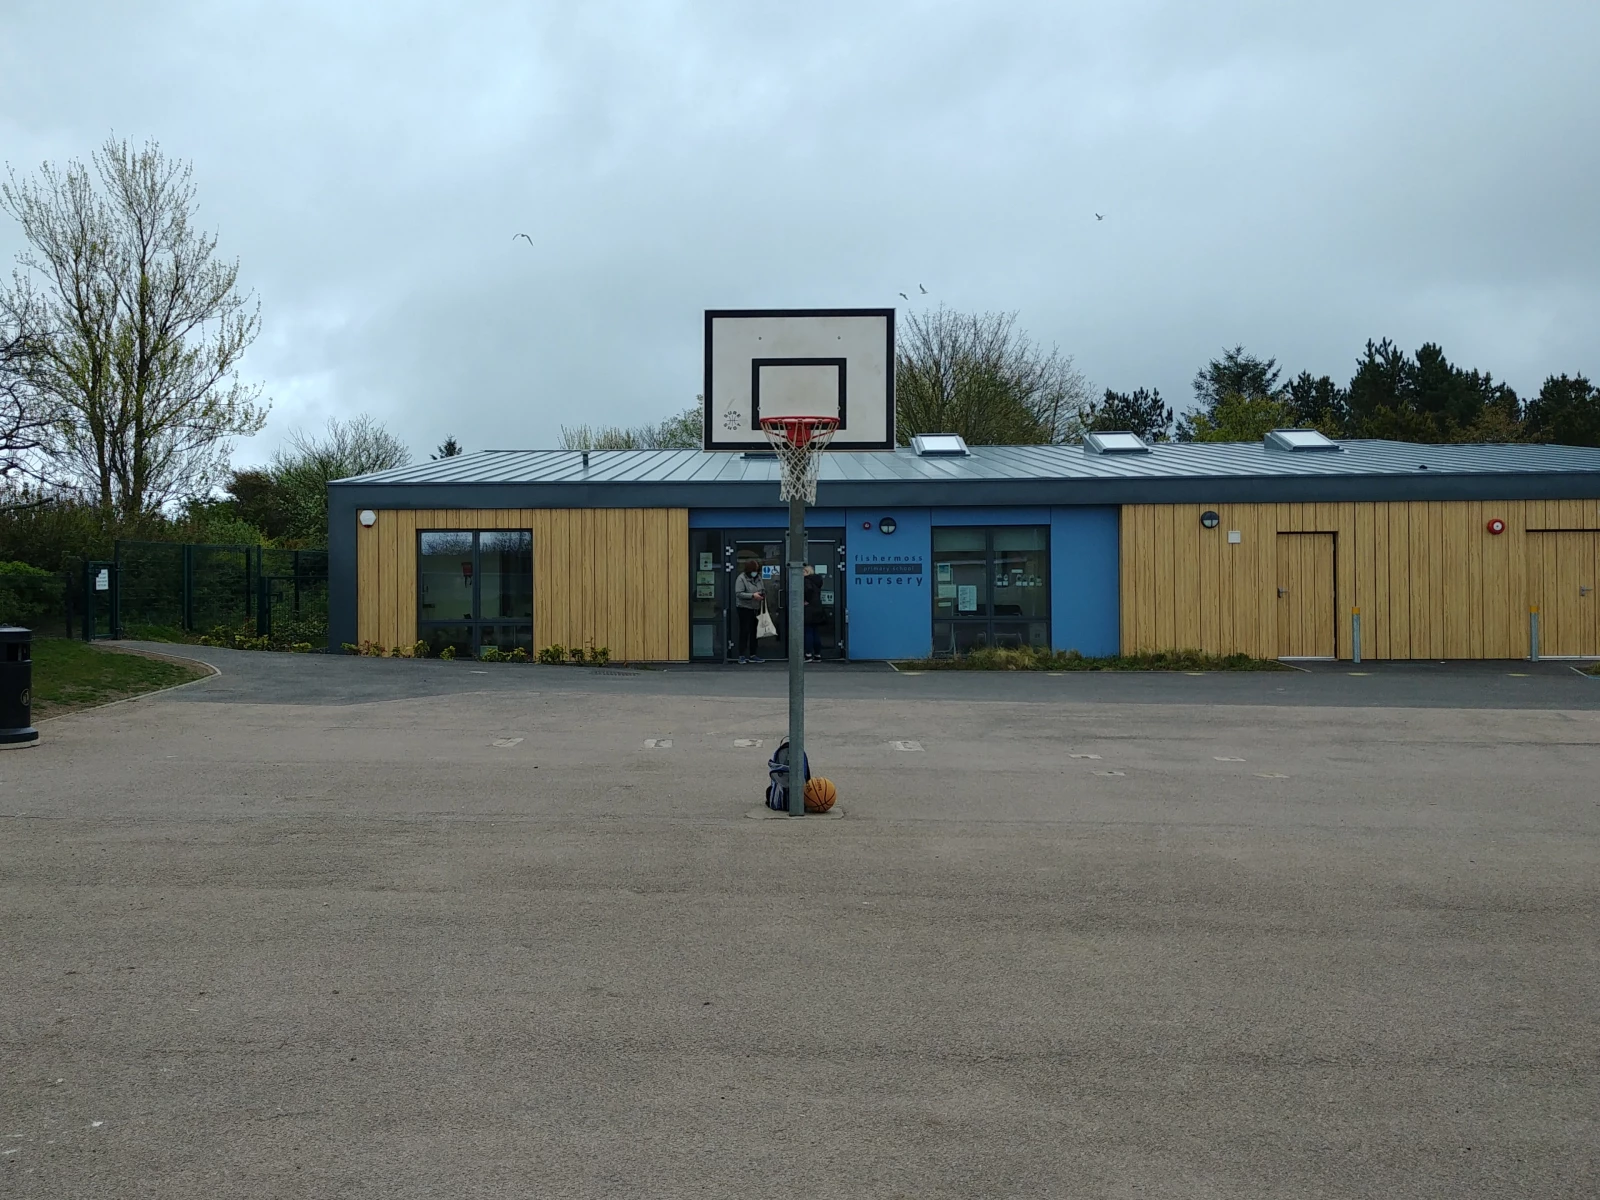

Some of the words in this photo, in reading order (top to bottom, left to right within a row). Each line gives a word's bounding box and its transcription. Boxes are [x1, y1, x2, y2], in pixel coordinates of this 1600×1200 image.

[723, 410, 741, 418] SURE
[723, 423, 741, 431] SHOT
[855, 554, 923, 562] fishermoss
[855, 576, 923, 587] nursery
